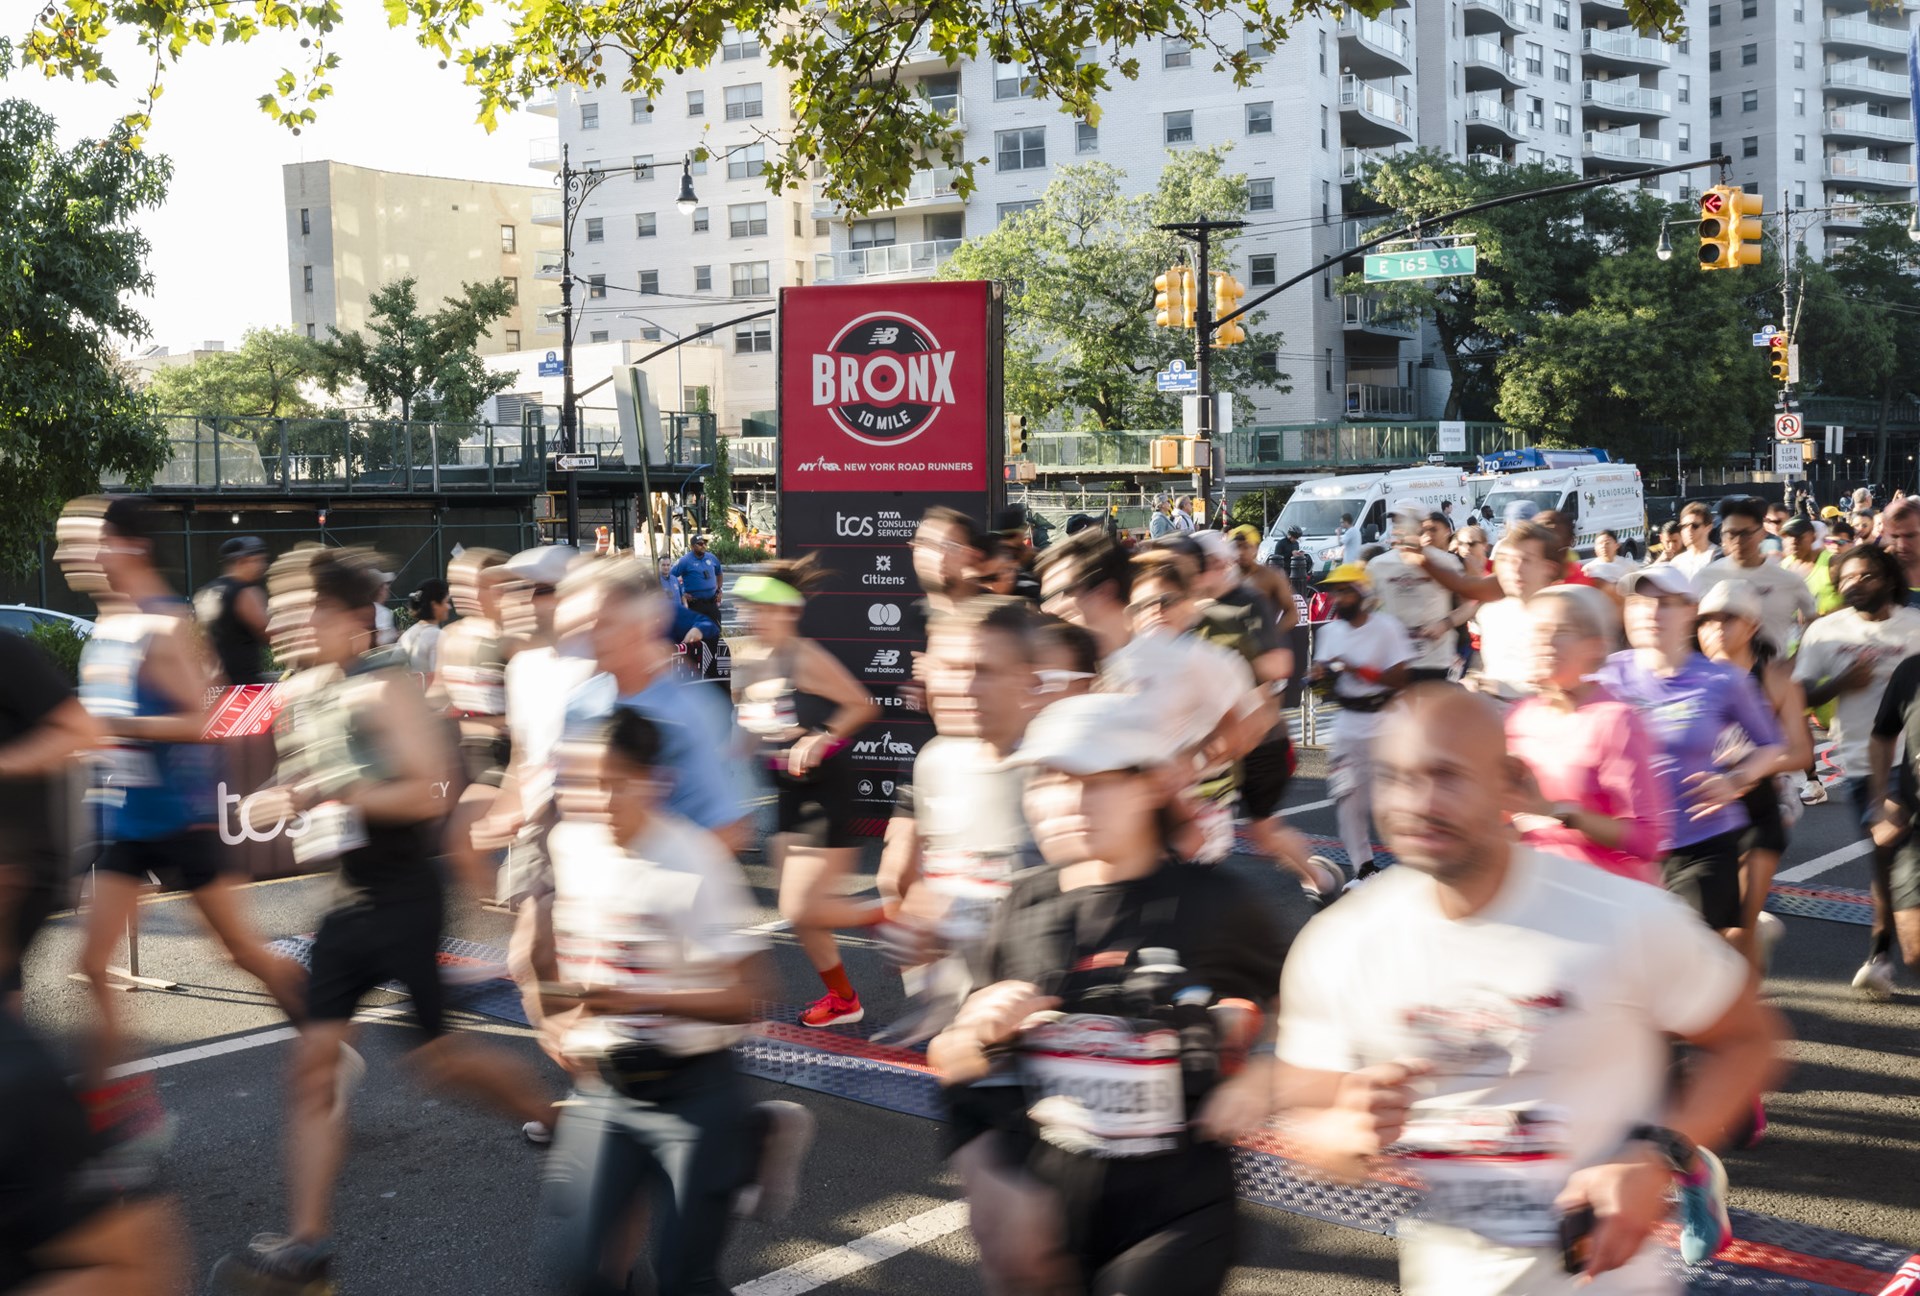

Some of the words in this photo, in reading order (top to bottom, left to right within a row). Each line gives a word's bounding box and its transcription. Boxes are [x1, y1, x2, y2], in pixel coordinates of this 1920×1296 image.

[1379, 261, 1389, 274] E
[1400, 257, 1428, 273] 165
[1440, 255, 1459, 269] St
[812, 350, 956, 406] BRONX
[858, 410, 873, 428] 10
[876, 409, 911, 430] MILE
[561, 458, 573, 466] ONE
[844, 463, 867, 471] NEW
[869, 463, 896, 471] YORK
[898, 463, 926, 471] ROAD
[928, 463, 973, 471] RUNNERS
[1408, 480, 1445, 489] AMBULANCE
[1597, 487, 1635, 498] SENIORCARE
[877, 511, 901, 519] TATA
[836, 511, 874, 536] tcs
[877, 529, 913, 537] SERVICES
[862, 574, 905, 585] Citizens
[878, 666, 905, 674] balance
